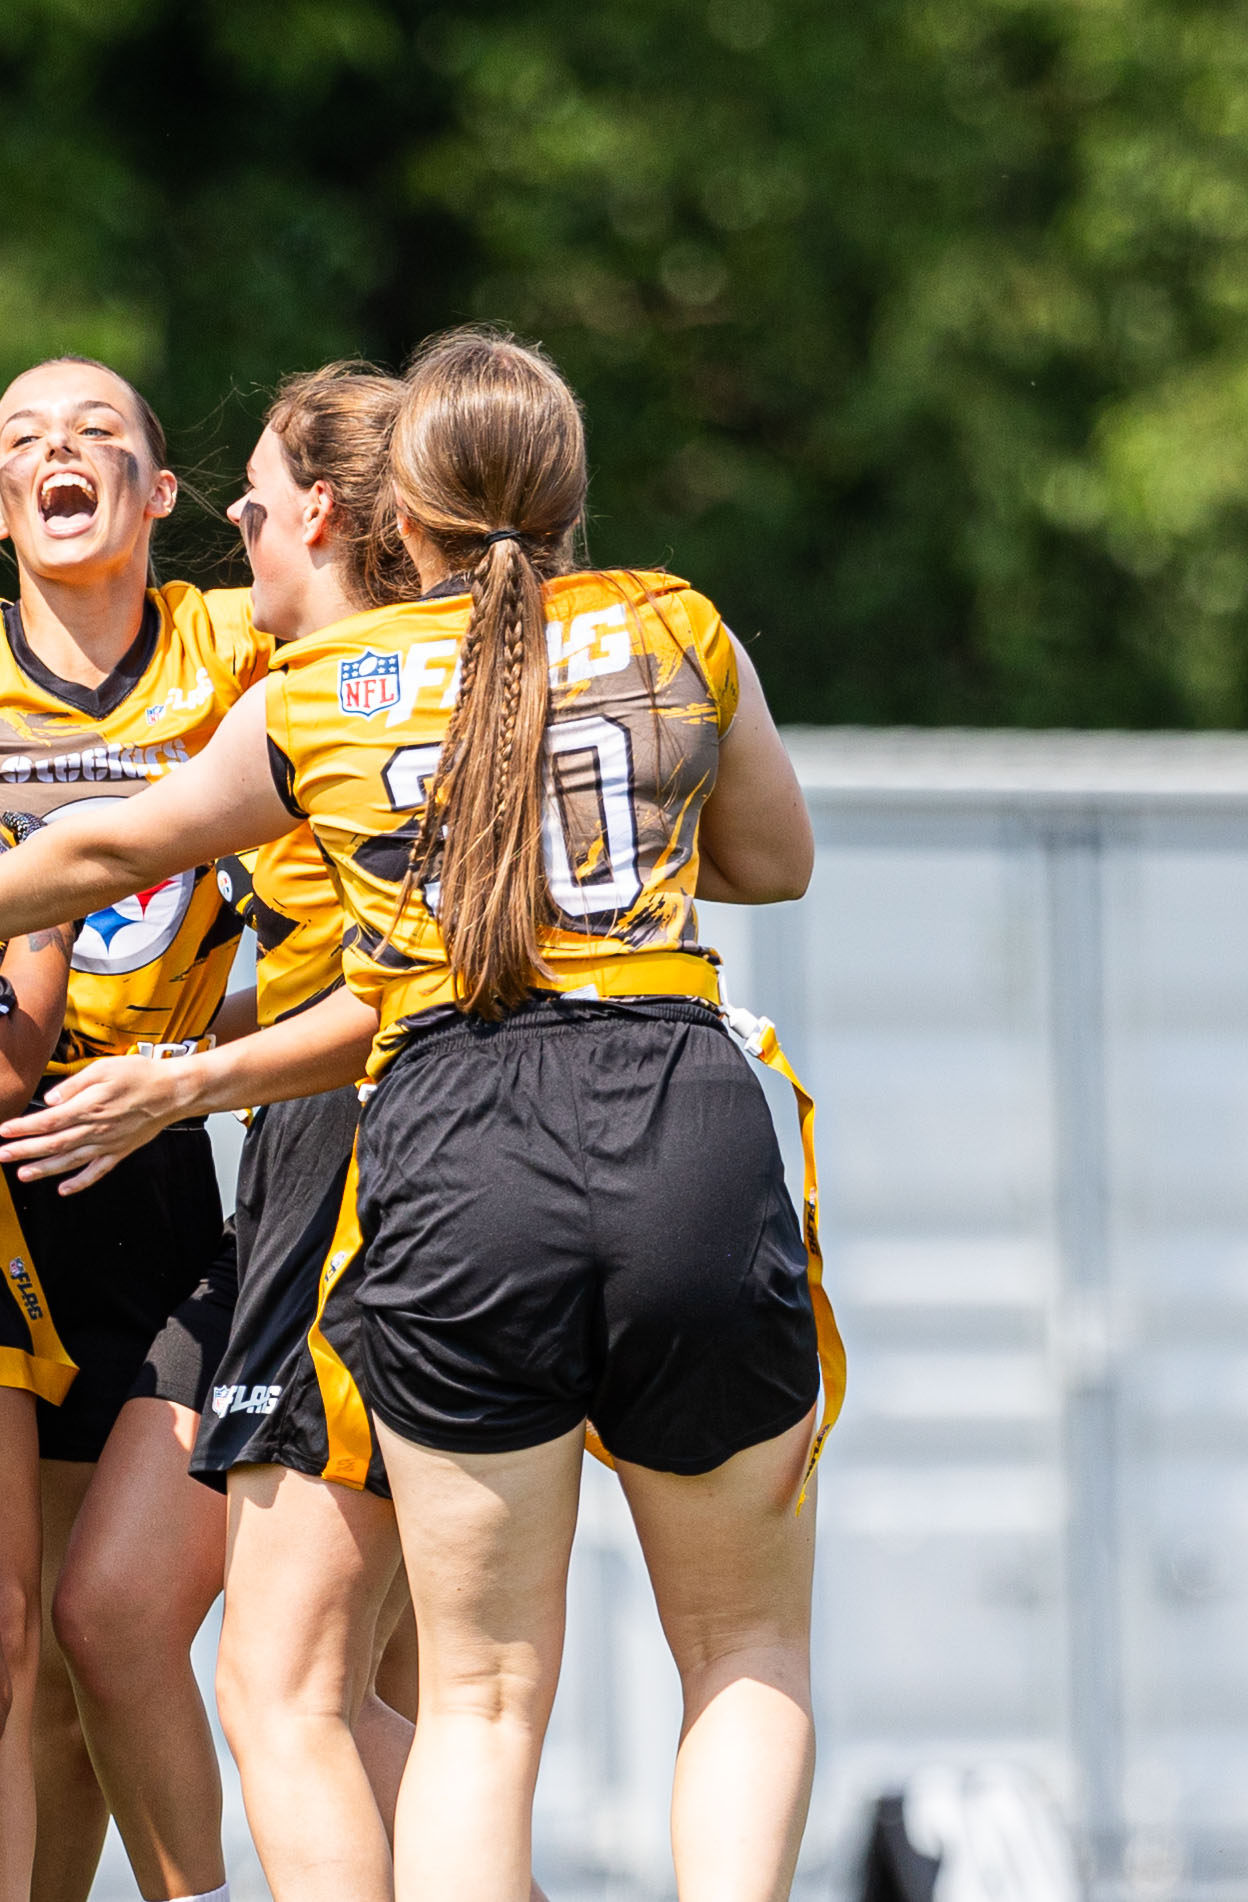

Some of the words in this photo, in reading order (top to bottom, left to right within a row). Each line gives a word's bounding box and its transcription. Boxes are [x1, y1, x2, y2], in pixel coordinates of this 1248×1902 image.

[345, 678, 395, 708] NFL
[385, 603, 631, 728] FG
[10, 1271, 43, 1320] FLAG
[220, 1385, 282, 1419] FLAG
